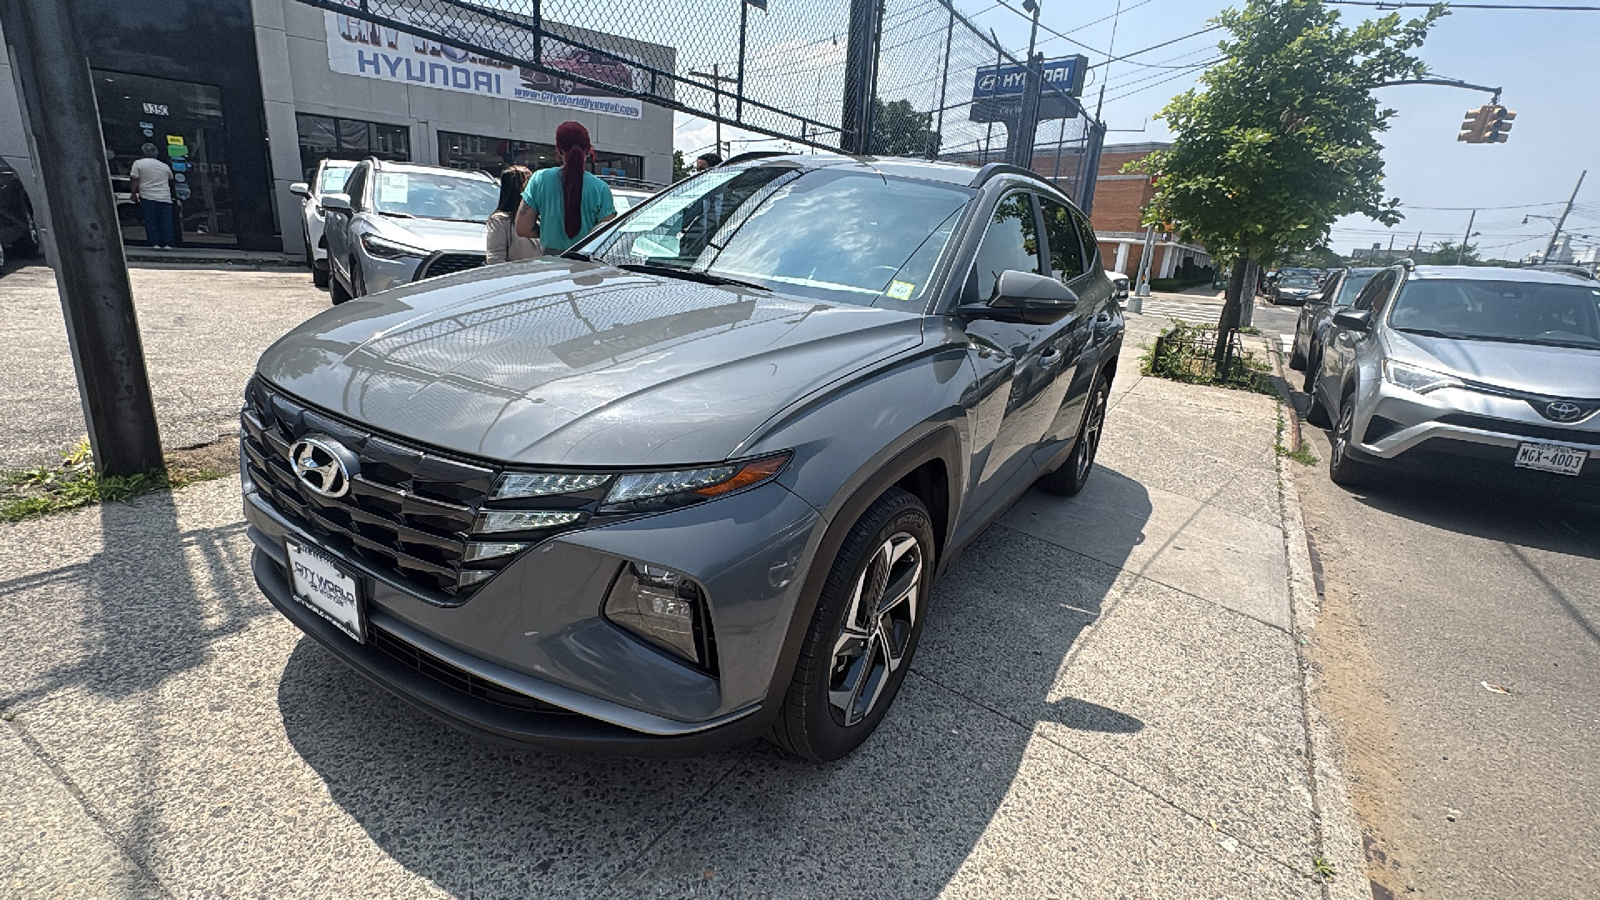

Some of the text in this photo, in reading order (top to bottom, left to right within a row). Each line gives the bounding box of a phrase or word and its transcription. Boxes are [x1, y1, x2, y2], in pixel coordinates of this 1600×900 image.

[357, 49, 502, 95] HYUNDAI
[1002, 67, 1069, 88] HYDAI
[514, 87, 640, 117] www.CityWorldHyundai.com
[1519, 447, 1582, 469] MGX-4003
[316, 573, 355, 604] WORLD
